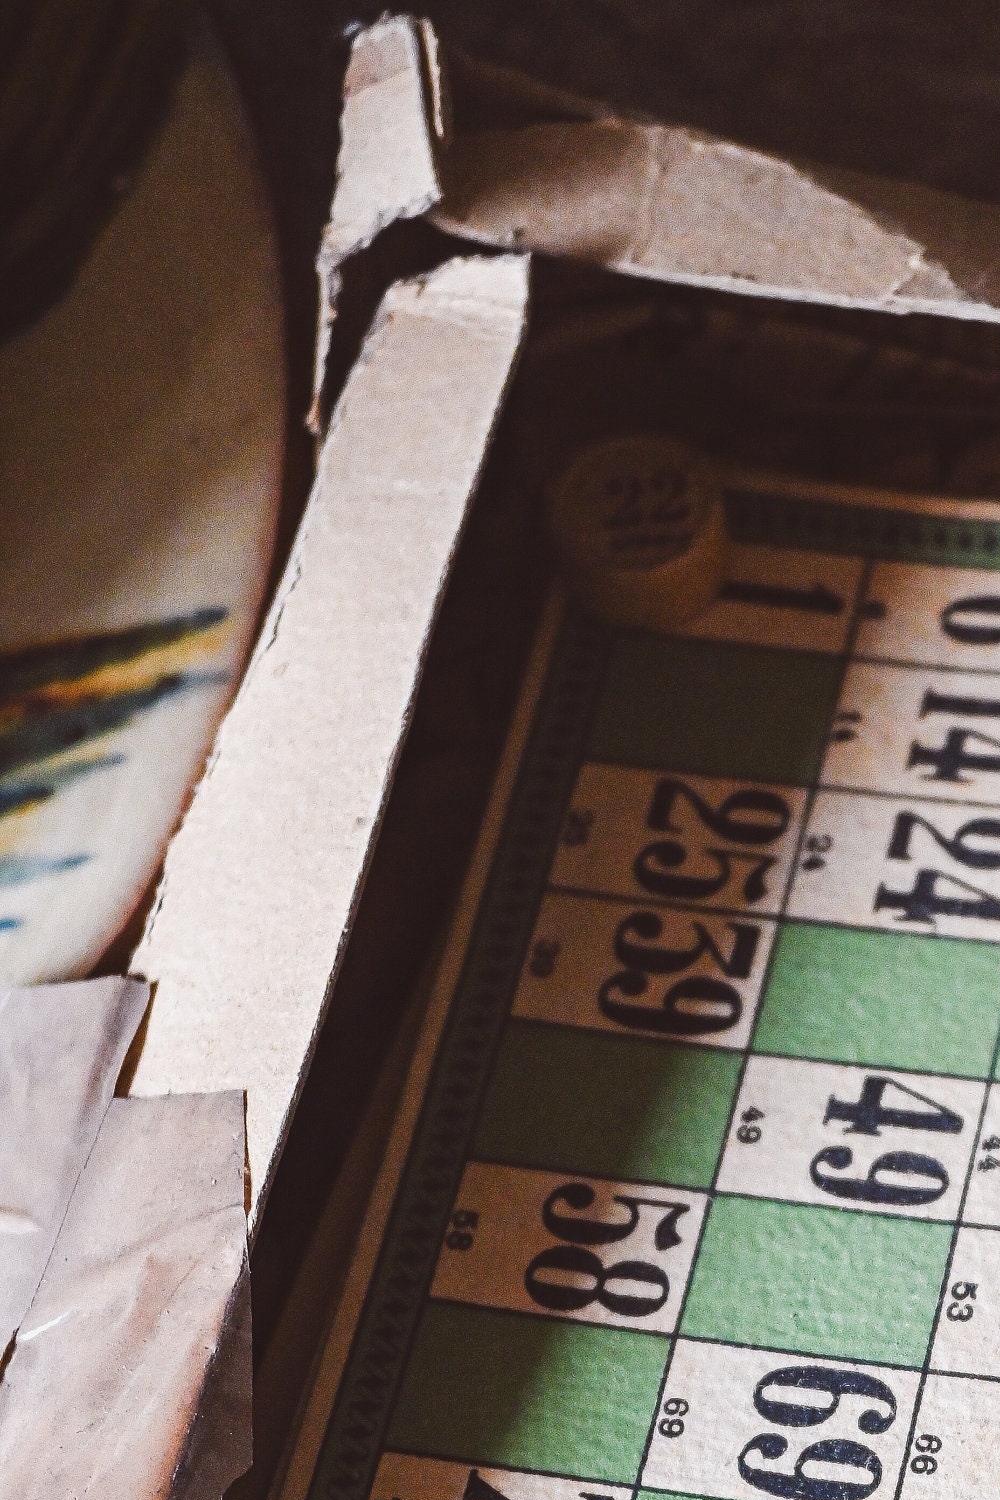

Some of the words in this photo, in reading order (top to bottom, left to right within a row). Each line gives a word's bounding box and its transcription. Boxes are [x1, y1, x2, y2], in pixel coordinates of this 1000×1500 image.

[632, 778, 792, 903] 25
[598, 911, 762, 1036] 39
[735, 1105, 764, 1146] 49
[808, 1075, 964, 1209] 49
[444, 1208, 481, 1253] 58
[523, 1183, 692, 1318] 58
[946, 1280, 977, 1323] 53
[656, 1397, 690, 1439] 69
[911, 1433, 943, 1477] 66
